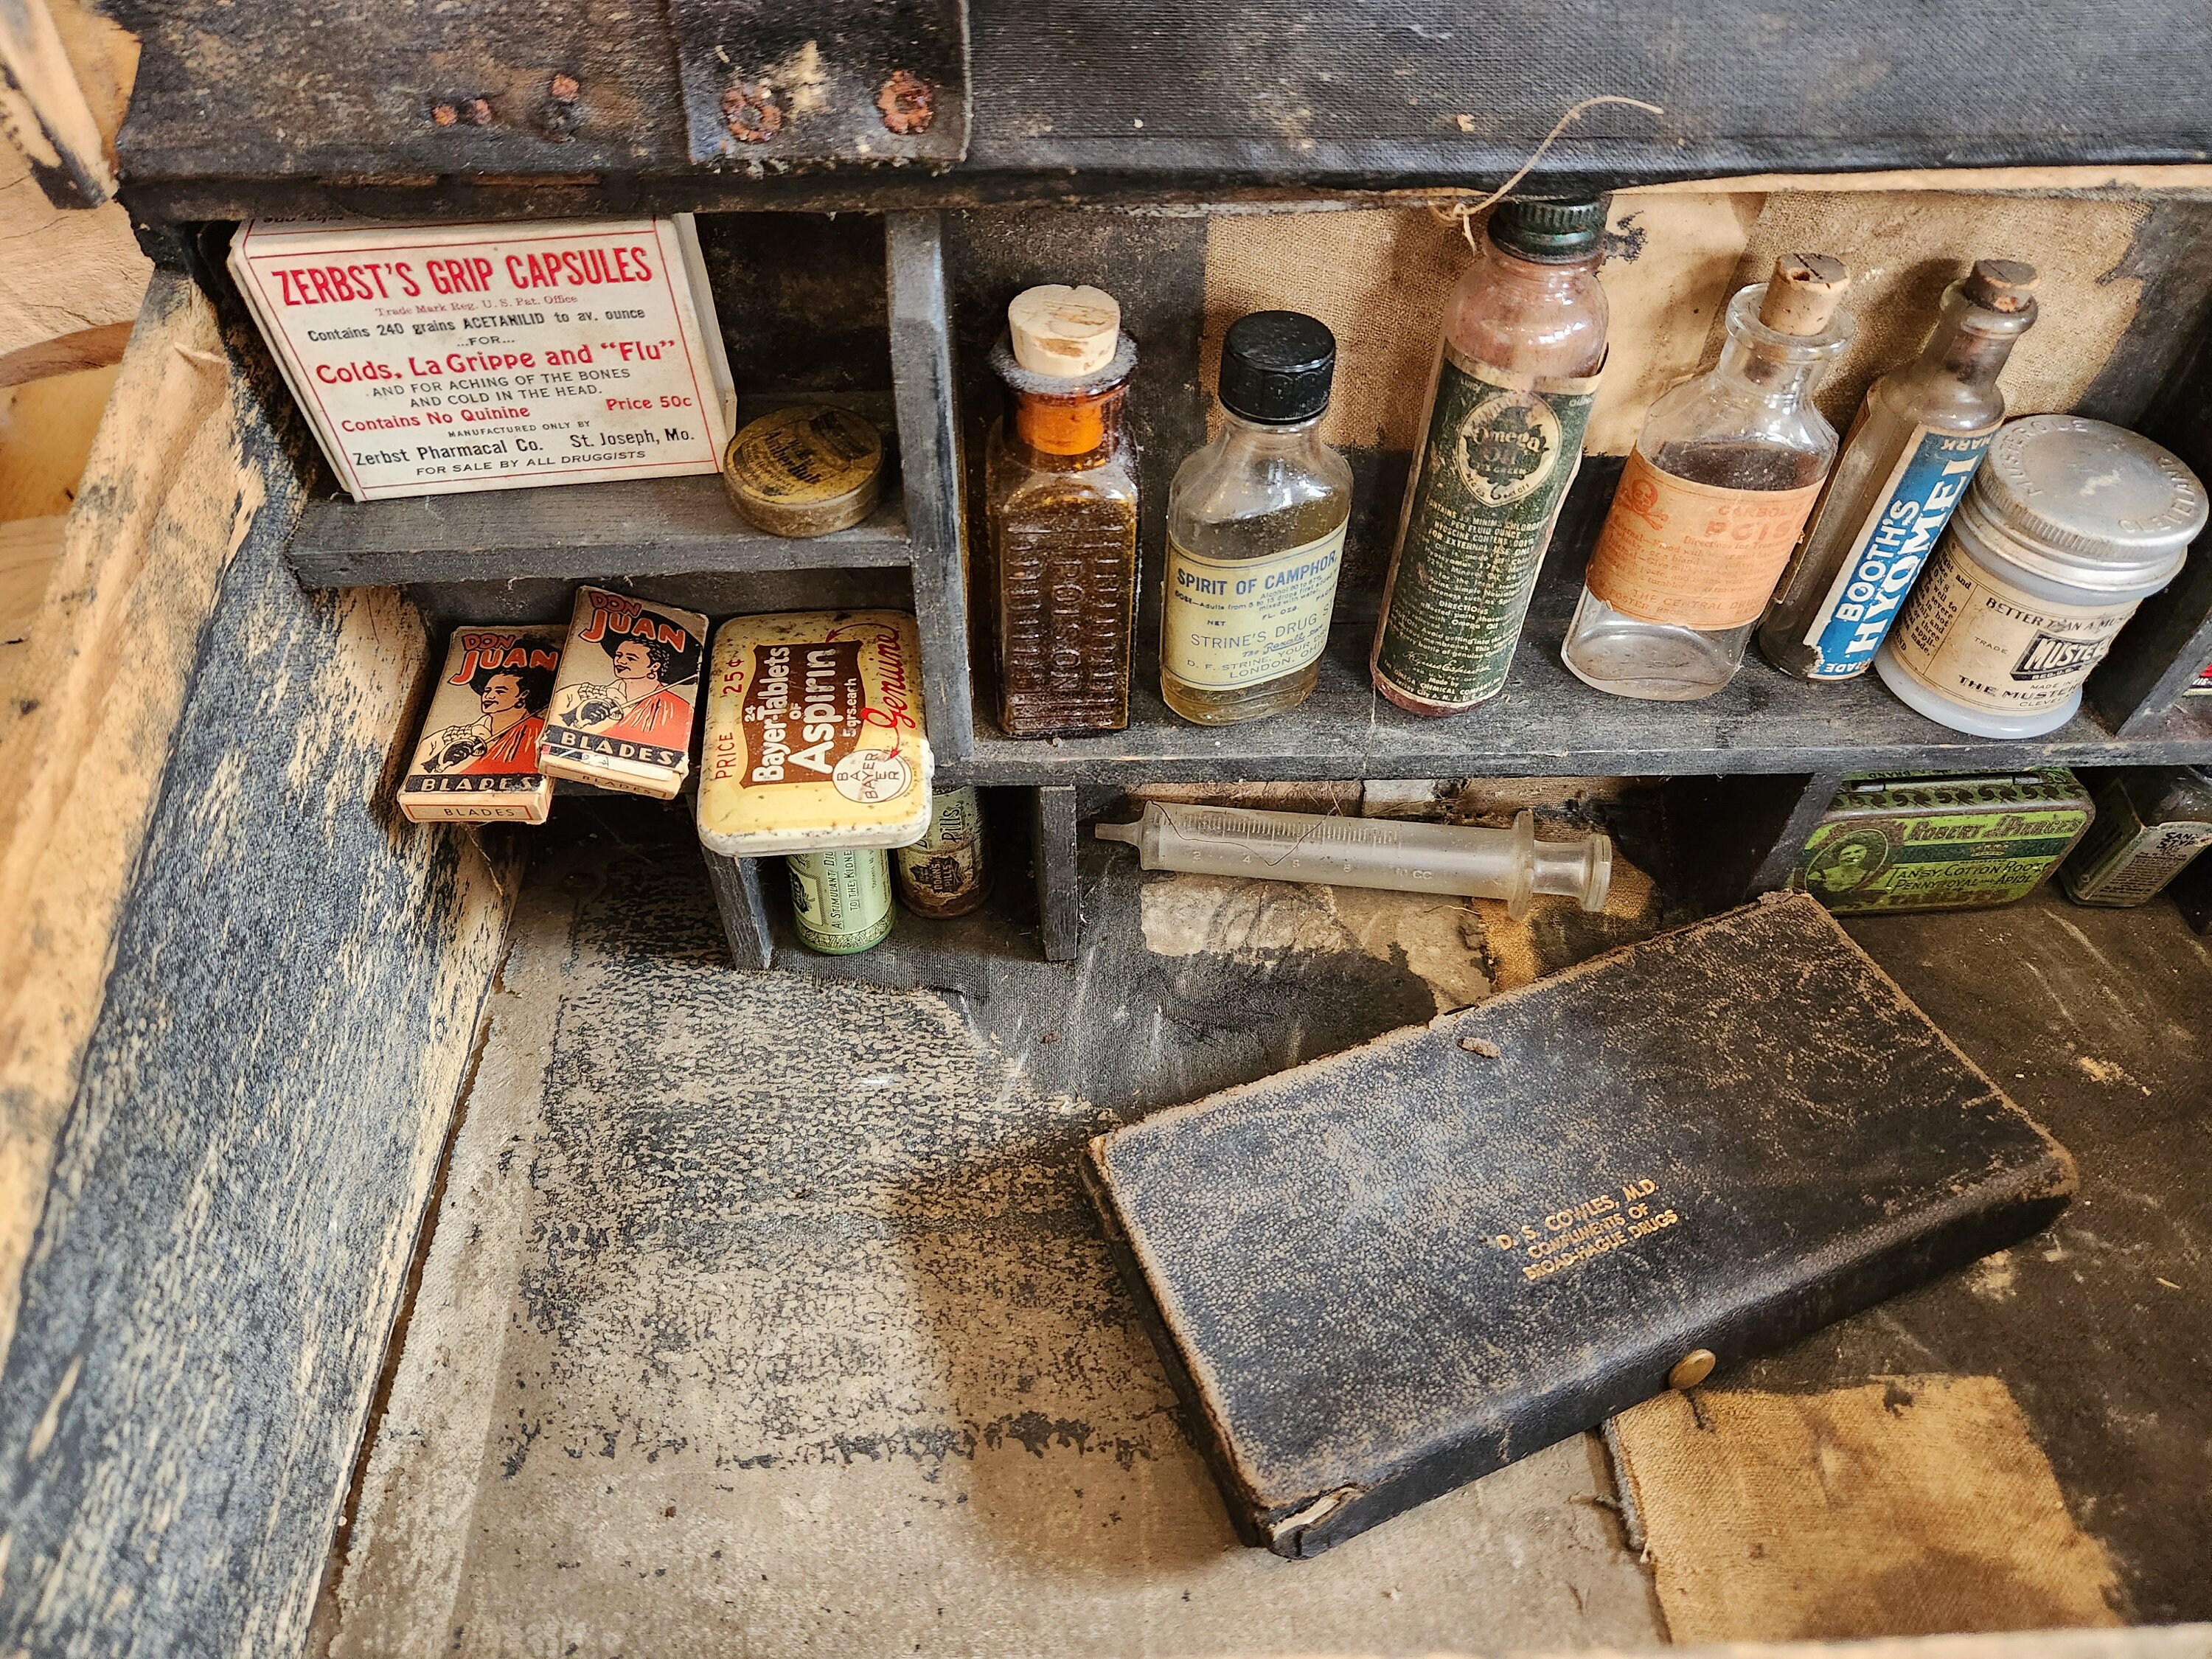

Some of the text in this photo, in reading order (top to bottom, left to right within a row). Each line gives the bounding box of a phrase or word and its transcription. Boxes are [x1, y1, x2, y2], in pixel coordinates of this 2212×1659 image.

[271, 246, 653, 306] ZERBST'S GRIP CAPSULES
[375, 307, 413, 316] Trade
[415, 304, 447, 313] Mark
[451, 302, 479, 313] Reg.
[515, 296, 540, 307] Pat.
[543, 294, 578, 305] Office
[307, 327, 369, 342] Contains
[376, 322, 404, 336] 240
[411, 319, 456, 335] grains
[554, 312, 569, 323] to
[577, 313, 599, 322] av.
[605, 307, 645, 320] ounce
[316, 361, 403, 384] Colds,
[408, 356, 443, 377] La
[446, 351, 537, 374] Grippe
[545, 344, 594, 366] and
[372, 368, 630, 397] AND FOR ACHING OF THE BONES
[410, 384, 602, 408] AND COLD IN THE HEAD.
[605, 395, 692, 411] Price 50c
[341, 406, 531, 433] Contains No Quinine
[448, 420, 591, 438] MANUFACTURED ONLY BY
[353, 428, 695, 466] Zerbst Pharmacal Co. St. Joseph, Mo.
[417, 451, 646, 476] FOR SALE BY ALL DRUGGISTS
[1428, 529, 1444, 541] FOR
[1447, 538, 1488, 552] EXTERNAL
[1434, 520, 1470, 540] HYOSCINE
[1450, 520, 1465, 530] PER
[1468, 526, 1492, 535] FLUID
[1494, 529, 1522, 540] OUNCE
[1836, 499, 1920, 623] BOOTH'S
[1845, 457, 1978, 655] HYOMEI
[1177, 568, 1228, 596] SPIRIT
[1236, 578, 1257, 595] OF
[1259, 587, 1289, 599] Alcohol
[1955, 574, 1972, 590] and
[590, 591, 642, 616] DON
[1259, 601, 1281, 611] mixed
[1439, 599, 1489, 614] DIRECTIONS
[1464, 594, 1482, 602] such
[1632, 589, 1658, 603] THE
[1934, 585, 1958, 613] well to
[1931, 596, 1954, 620] severe
[1935, 611, 1950, 627] hot
[1986, 597, 2045, 627] BETTER
[2084, 622, 2096, 630] A
[580, 611, 686, 653] JUAN
[1051, 559, 1084, 690] POISON
[1191, 613, 1317, 650] STRINE'S DRUG
[1422, 627, 1472, 645] Avoid getting
[1451, 619, 1498, 630] Omega Oil
[1921, 621, 1940, 641] three
[1930, 619, 1945, 635] and
[462, 633, 516, 652] DON
[1263, 632, 1306, 655] Rexall
[1419, 639, 1440, 653] bottle
[1452, 650, 1484, 662] genuine
[1911, 633, 1930, 656] made,
[1974, 636, 2009, 654] TRADE
[1187, 659, 1199, 669] D.
[1279, 641, 1311, 658] YOUR
[447, 648, 558, 686] JUAN
[860, 630, 916, 728] Genuine
[1420, 683, 1455, 695] CHEMICAL
[1429, 677, 1459, 688] Made by
[1959, 675, 2000, 697] THE
[744, 704, 757, 723] 24
[752, 646, 790, 782] Bayer-Tablets
[787, 647, 844, 774] Aspirin
[789, 702, 803, 720] OF
[561, 730, 675, 765] BLADES
[714, 731, 737, 779] PRICE
[420, 776, 533, 792] BLADES
[582, 775, 651, 795] BLADES
[862, 752, 879, 799] BAYER
[443, 807, 515, 817] BLADES
[1905, 821, 1985, 841] ROBERT
[824, 851, 835, 866] DIU
[844, 850, 854, 878] KIDNE
[1193, 851, 1201, 860] 2
[1242, 854, 1252, 864] 4
[1343, 863, 1352, 872] 8
[1944, 863, 2002, 876] COTTON
[1891, 878, 1979, 894] PENNYOYAL
[1496, 1179, 1659, 1251] D. S. COWLES, M.D.
[1627, 1209, 1679, 1239] DRUGS
[1527, 1203, 1649, 1259] COMPLIMENTS OF
